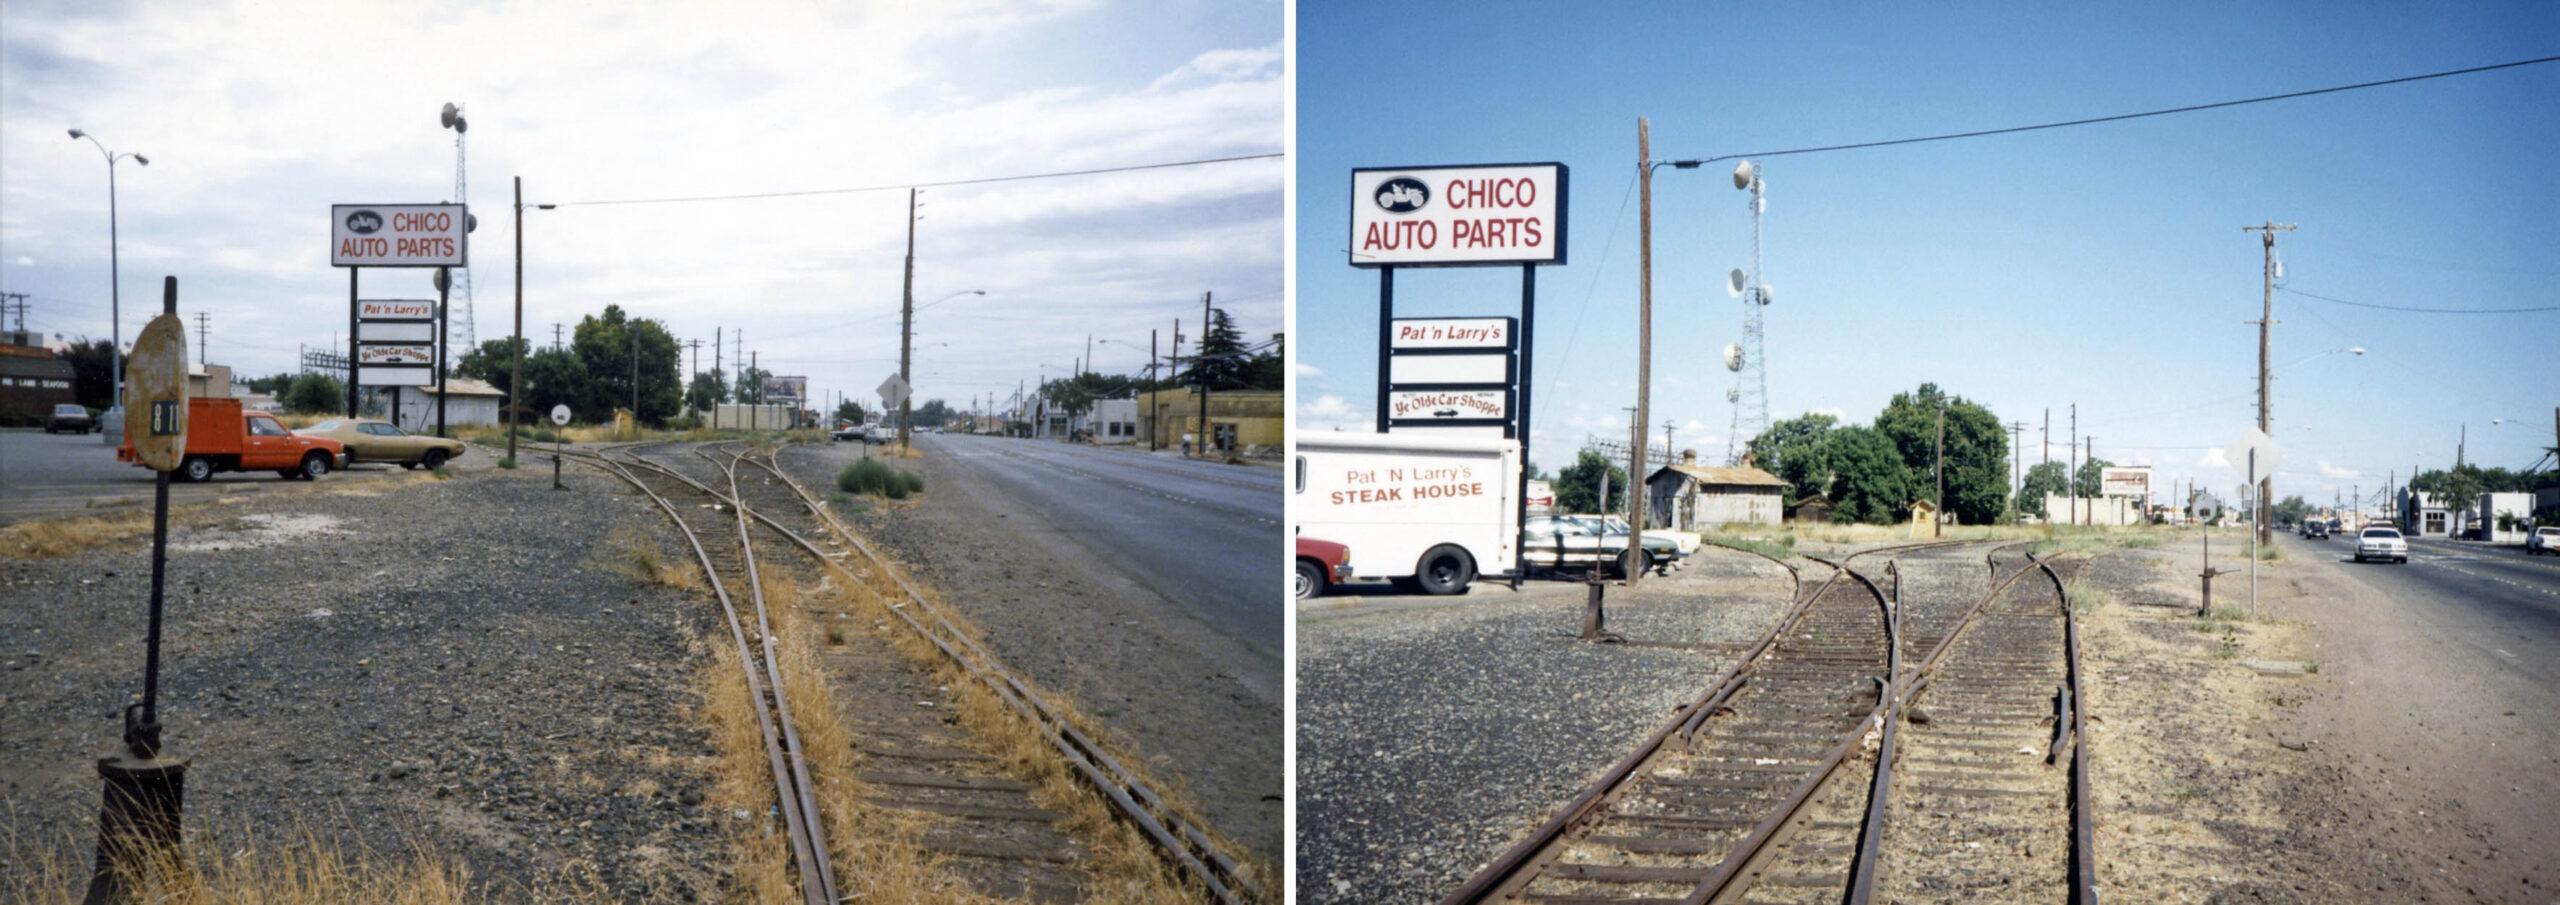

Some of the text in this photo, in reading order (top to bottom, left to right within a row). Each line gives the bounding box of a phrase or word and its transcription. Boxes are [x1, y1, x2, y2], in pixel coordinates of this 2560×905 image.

[1446, 177, 1536, 209] CHICO
[393, 212, 451, 232] CHICO
[1363, 217, 1542, 250] AUTO PARTS
[340, 238, 455, 257] AUTO PARTS
[364, 304, 381, 314] Pat
[394, 304, 429, 317] Larry's
[1400, 324, 1501, 342] Pat 'n Larry's
[1395, 393, 1501, 416] Ye Olde Car Shoppe
[155, 403, 162, 432] 8
[1347, 464, 1472, 484] Pat 'N Larry's
[1331, 482, 1483, 505] STEAK HOUSE
